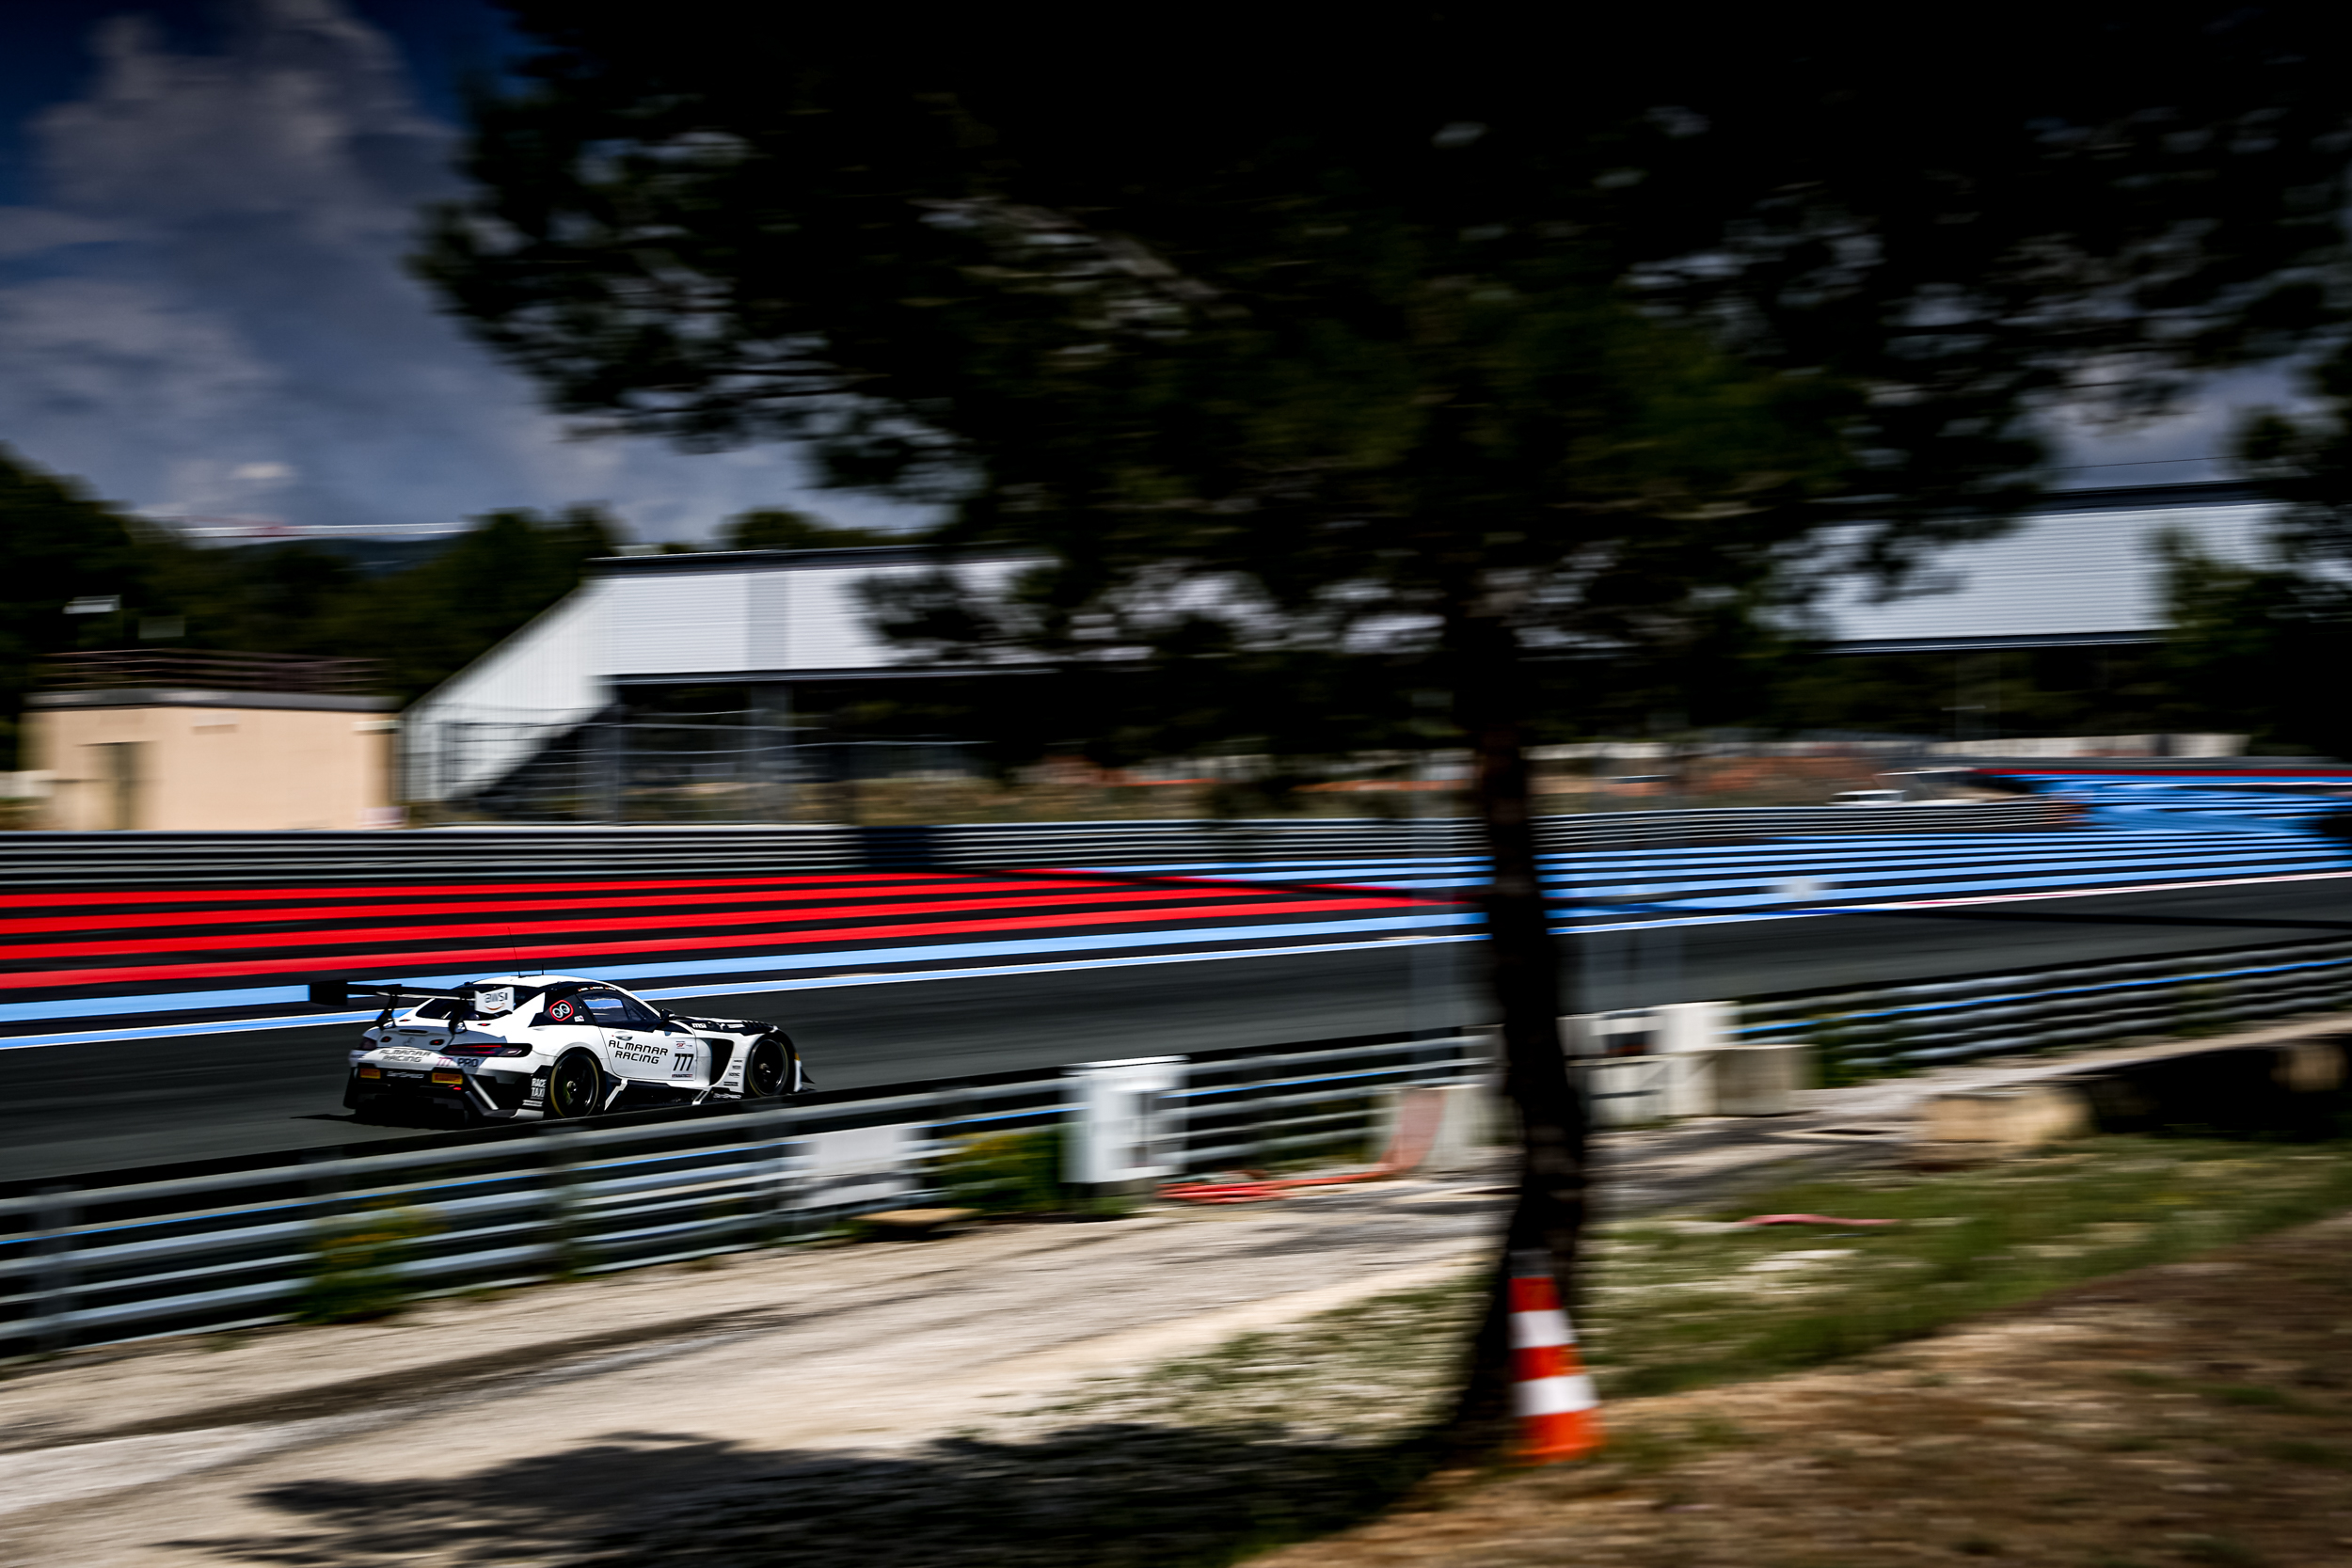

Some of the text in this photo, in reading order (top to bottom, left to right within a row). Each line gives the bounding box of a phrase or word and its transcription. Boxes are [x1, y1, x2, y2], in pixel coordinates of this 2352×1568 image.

[608, 1039, 669, 1056] ALMANAR
[436, 1056, 479, 1068] 777 PRO
[614, 1050, 660, 1065] RACING
[673, 1053, 694, 1071] 777
[531, 1077, 548, 1088] RACE
[531, 1086, 546, 1098] TAXI
